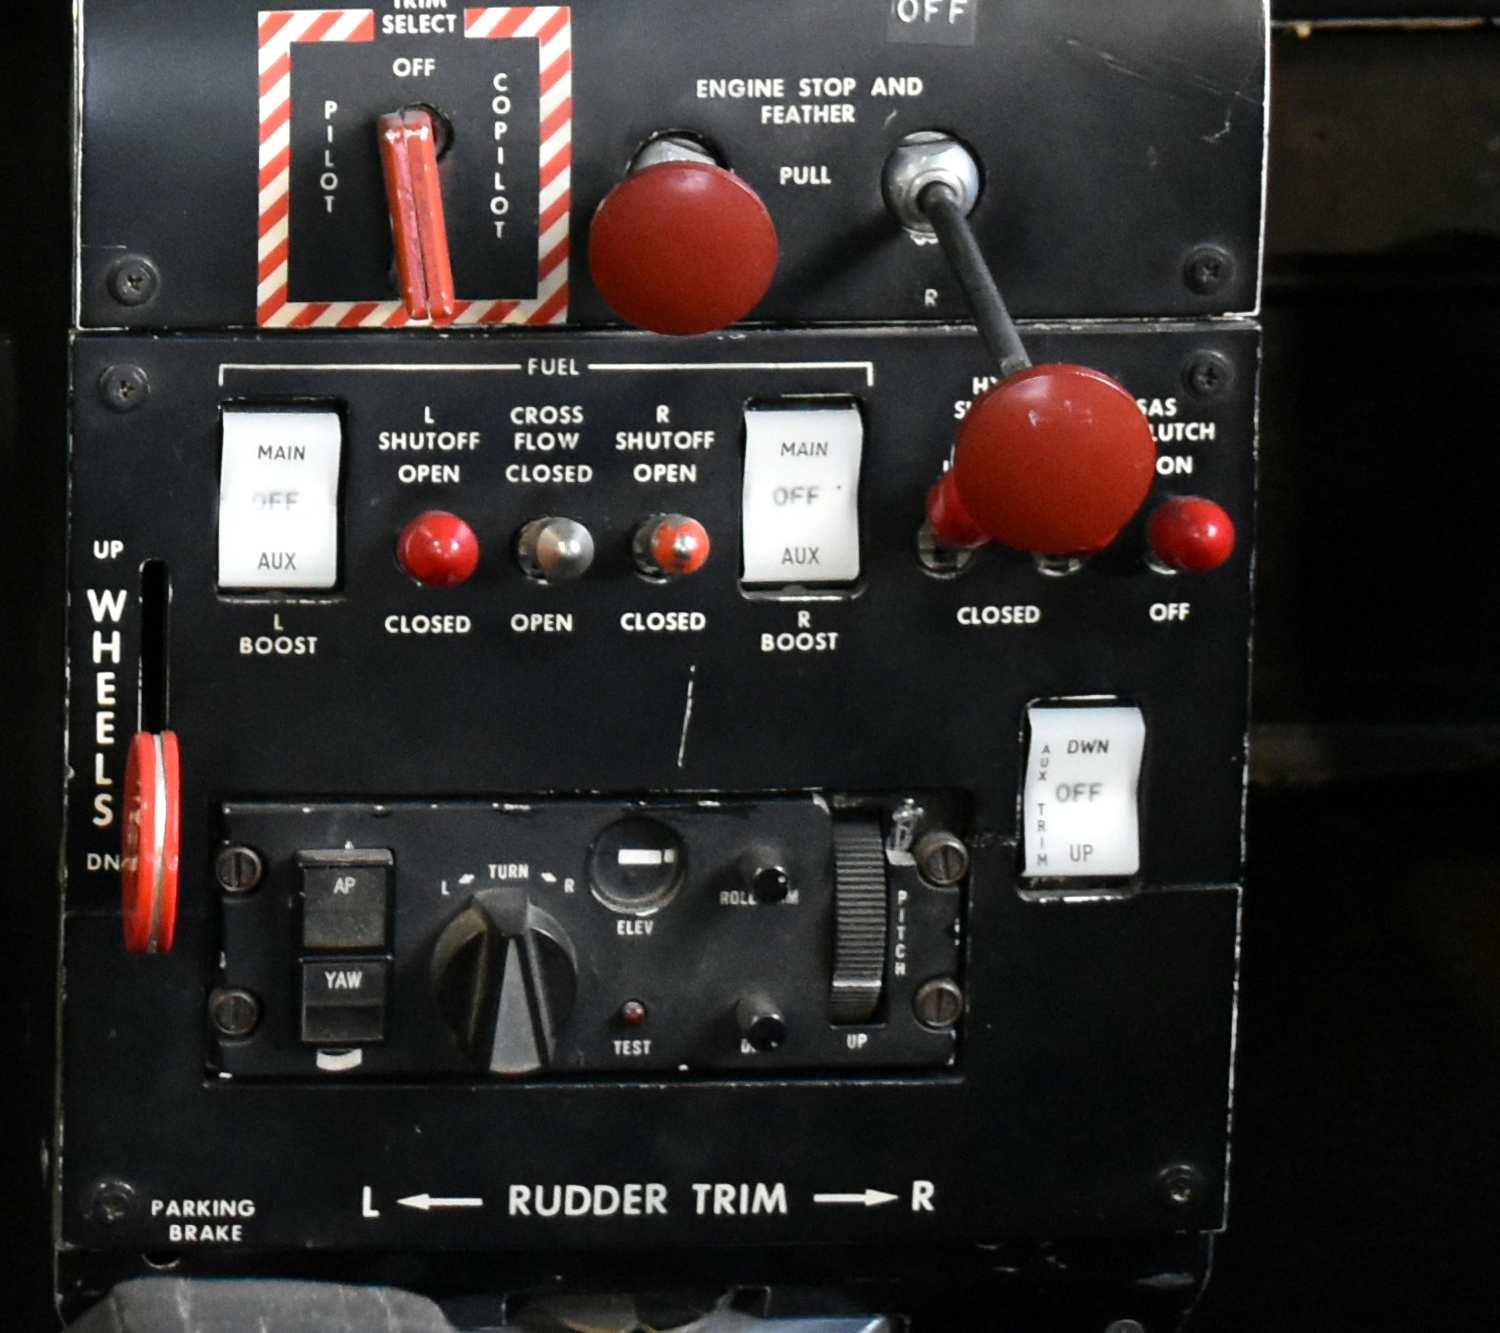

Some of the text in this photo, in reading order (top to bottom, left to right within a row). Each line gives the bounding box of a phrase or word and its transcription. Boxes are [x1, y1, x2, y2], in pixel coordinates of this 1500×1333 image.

[382, 13, 457, 35] SELECT
[392, 57, 436, 78] OFF
[696, 76, 924, 99] ENGINE STOP AND
[761, 103, 856, 125] FEATHER
[320, 101, 339, 213] PILOT
[490, 73, 510, 239] COPILOT
[779, 165, 832, 185] PULL
[527, 357, 580, 376] FUEL
[509, 405, 584, 425] CROSS
[378, 431, 480, 451] SHUTOFF
[514, 431, 580, 451] FLOW
[257, 444, 306, 461] MAIN
[397, 464, 460, 484] OPEN
[505, 464, 593, 483] CLOSED
[956, 605, 1041, 625] CLOSED
[1149, 602, 1190, 622] OFF
[239, 636, 318, 655] BOOST
[324, 971, 363, 989] YAW
[151, 1199, 256, 1218] PARKING
[508, 1182, 788, 1217] RUDDER TRIM
[169, 1224, 242, 1242] BRAKE
